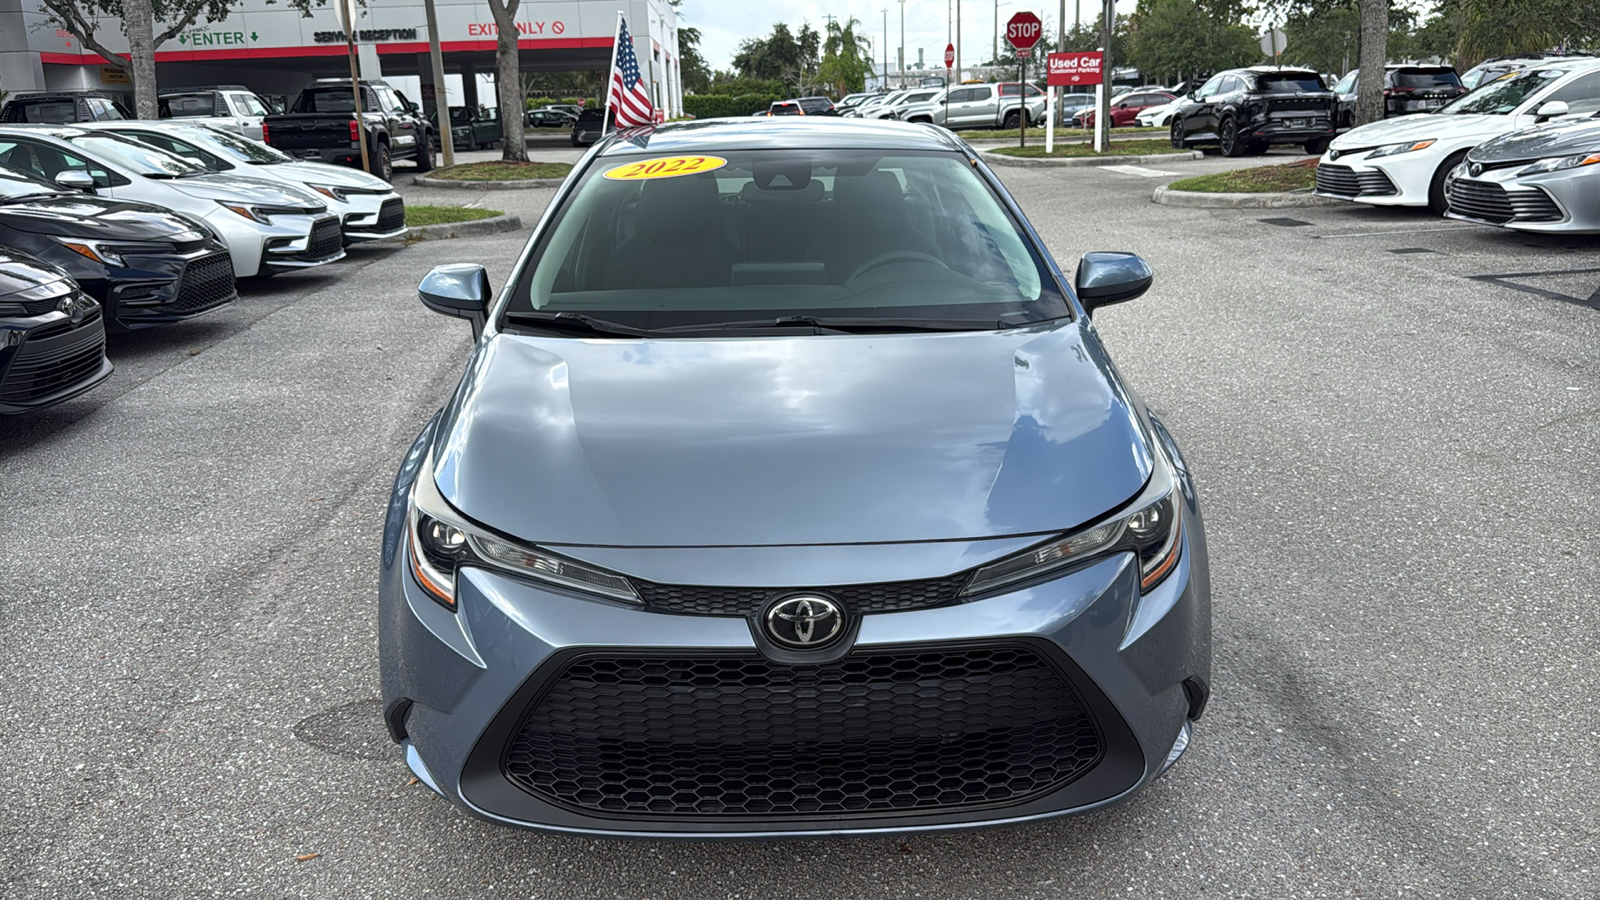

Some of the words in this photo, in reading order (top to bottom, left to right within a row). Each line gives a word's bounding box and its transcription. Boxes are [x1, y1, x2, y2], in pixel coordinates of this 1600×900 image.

[359, 28, 417, 40] RECEPTION
[468, 23, 499, 36] EXIT
[517, 22, 545, 35] NLY
[1008, 22, 1039, 38] STOP
[192, 31, 245, 46] ENTER
[1050, 57, 1078, 69] Used
[1080, 56, 1101, 67] Car
[622, 157, 705, 178] 2022
